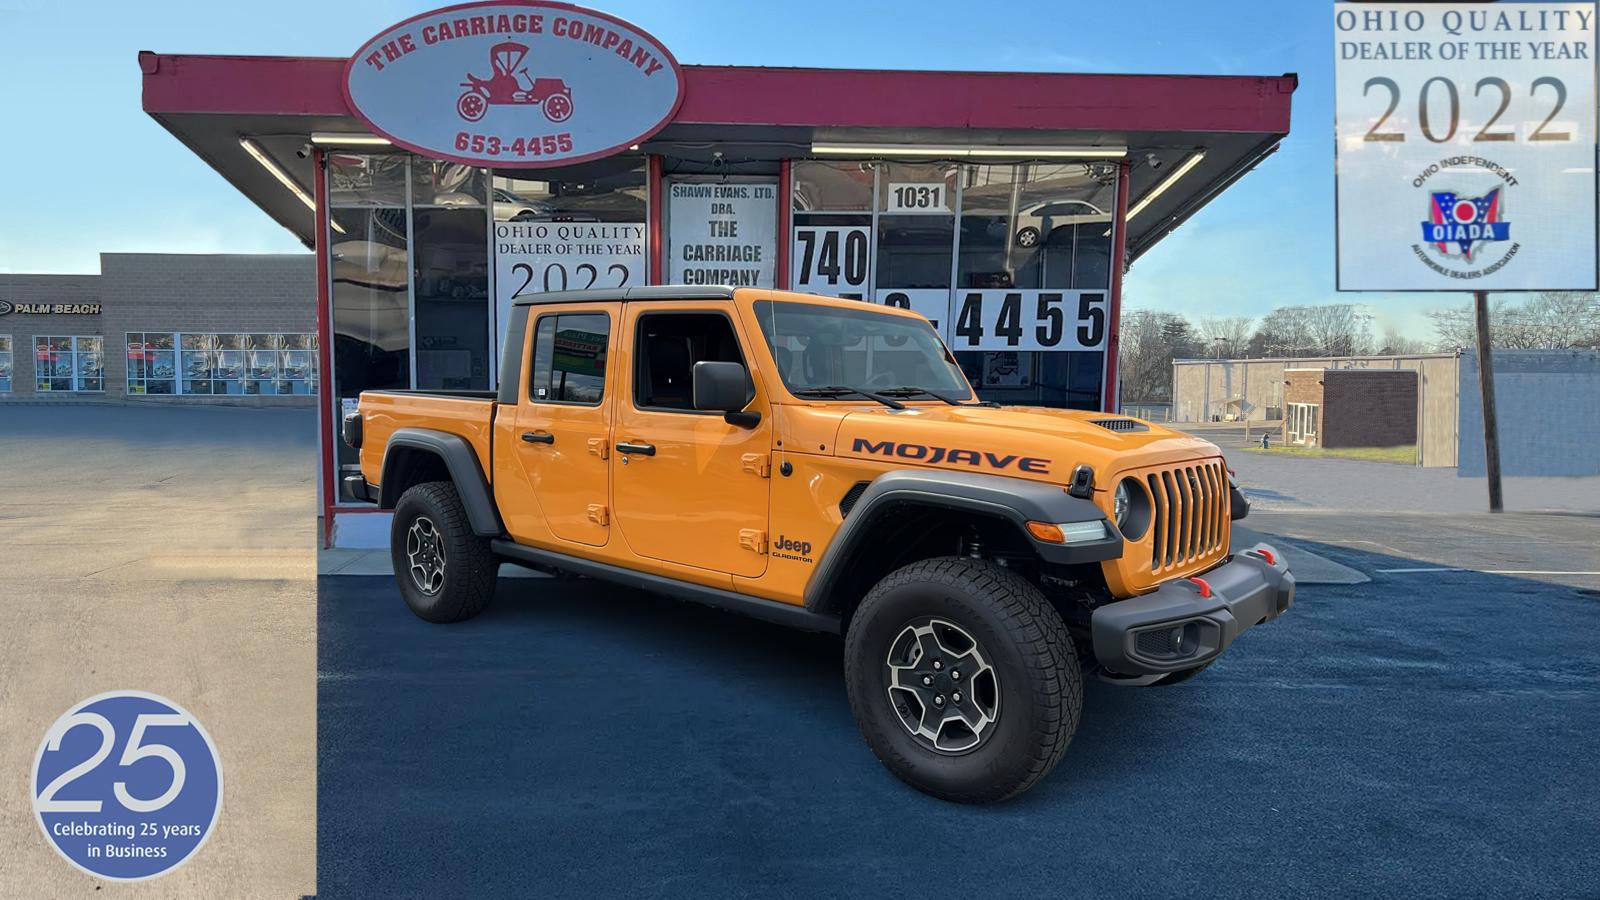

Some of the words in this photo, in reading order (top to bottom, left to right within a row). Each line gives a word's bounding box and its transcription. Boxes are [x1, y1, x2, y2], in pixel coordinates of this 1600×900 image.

[1336, 9, 1424, 31] OHIO
[1442, 9, 1593, 35] QUALITY
[365, 33, 417, 72] THE
[422, 14, 543, 46] CARRIAGE
[552, 16, 664, 77] COMPANY
[1340, 41, 1433, 60] DEALER
[1438, 41, 1469, 60] OF
[1475, 41, 1522, 60] THE
[1527, 41, 1589, 60] YEAR
[1362, 76, 1571, 144] 2022
[454, 132, 573, 156] 653-4455
[1412, 164, 1440, 188] OHIO
[1440, 155, 1519, 187] INDEPENDENT
[672, 185, 712, 198] SHAWN
[754, 187, 775, 200] LTD.
[894, 186, 940, 209] 1031
[711, 203, 736, 215] DBA.
[496, 225, 548, 239] OHIO
[557, 225, 644, 241] QUALITY
[708, 220, 738, 238] THE
[1432, 224, 1495, 241] OIADA
[499, 243, 552, 255] DEALER
[555, 243, 573, 255] OF
[576, 243, 603, 255] THE
[606, 243, 641, 255] YEAR
[683, 244, 762, 263] CARRIAGE
[797, 230, 868, 286] 740
[1411, 244, 1449, 276] AUTOMOBILE
[1450, 270, 1482, 280] DEALERS
[1483, 242, 1521, 276] ASSOCIATION
[511, 263, 630, 300] 2022
[683, 268, 761, 286] COMPANY
[14, 303, 51, 314] PALM
[54, 303, 100, 314] BEACH
[851, 437, 1052, 475] MOJAVE
[774, 534, 812, 556] Jeep
[772, 551, 813, 563] GLADIATOR
